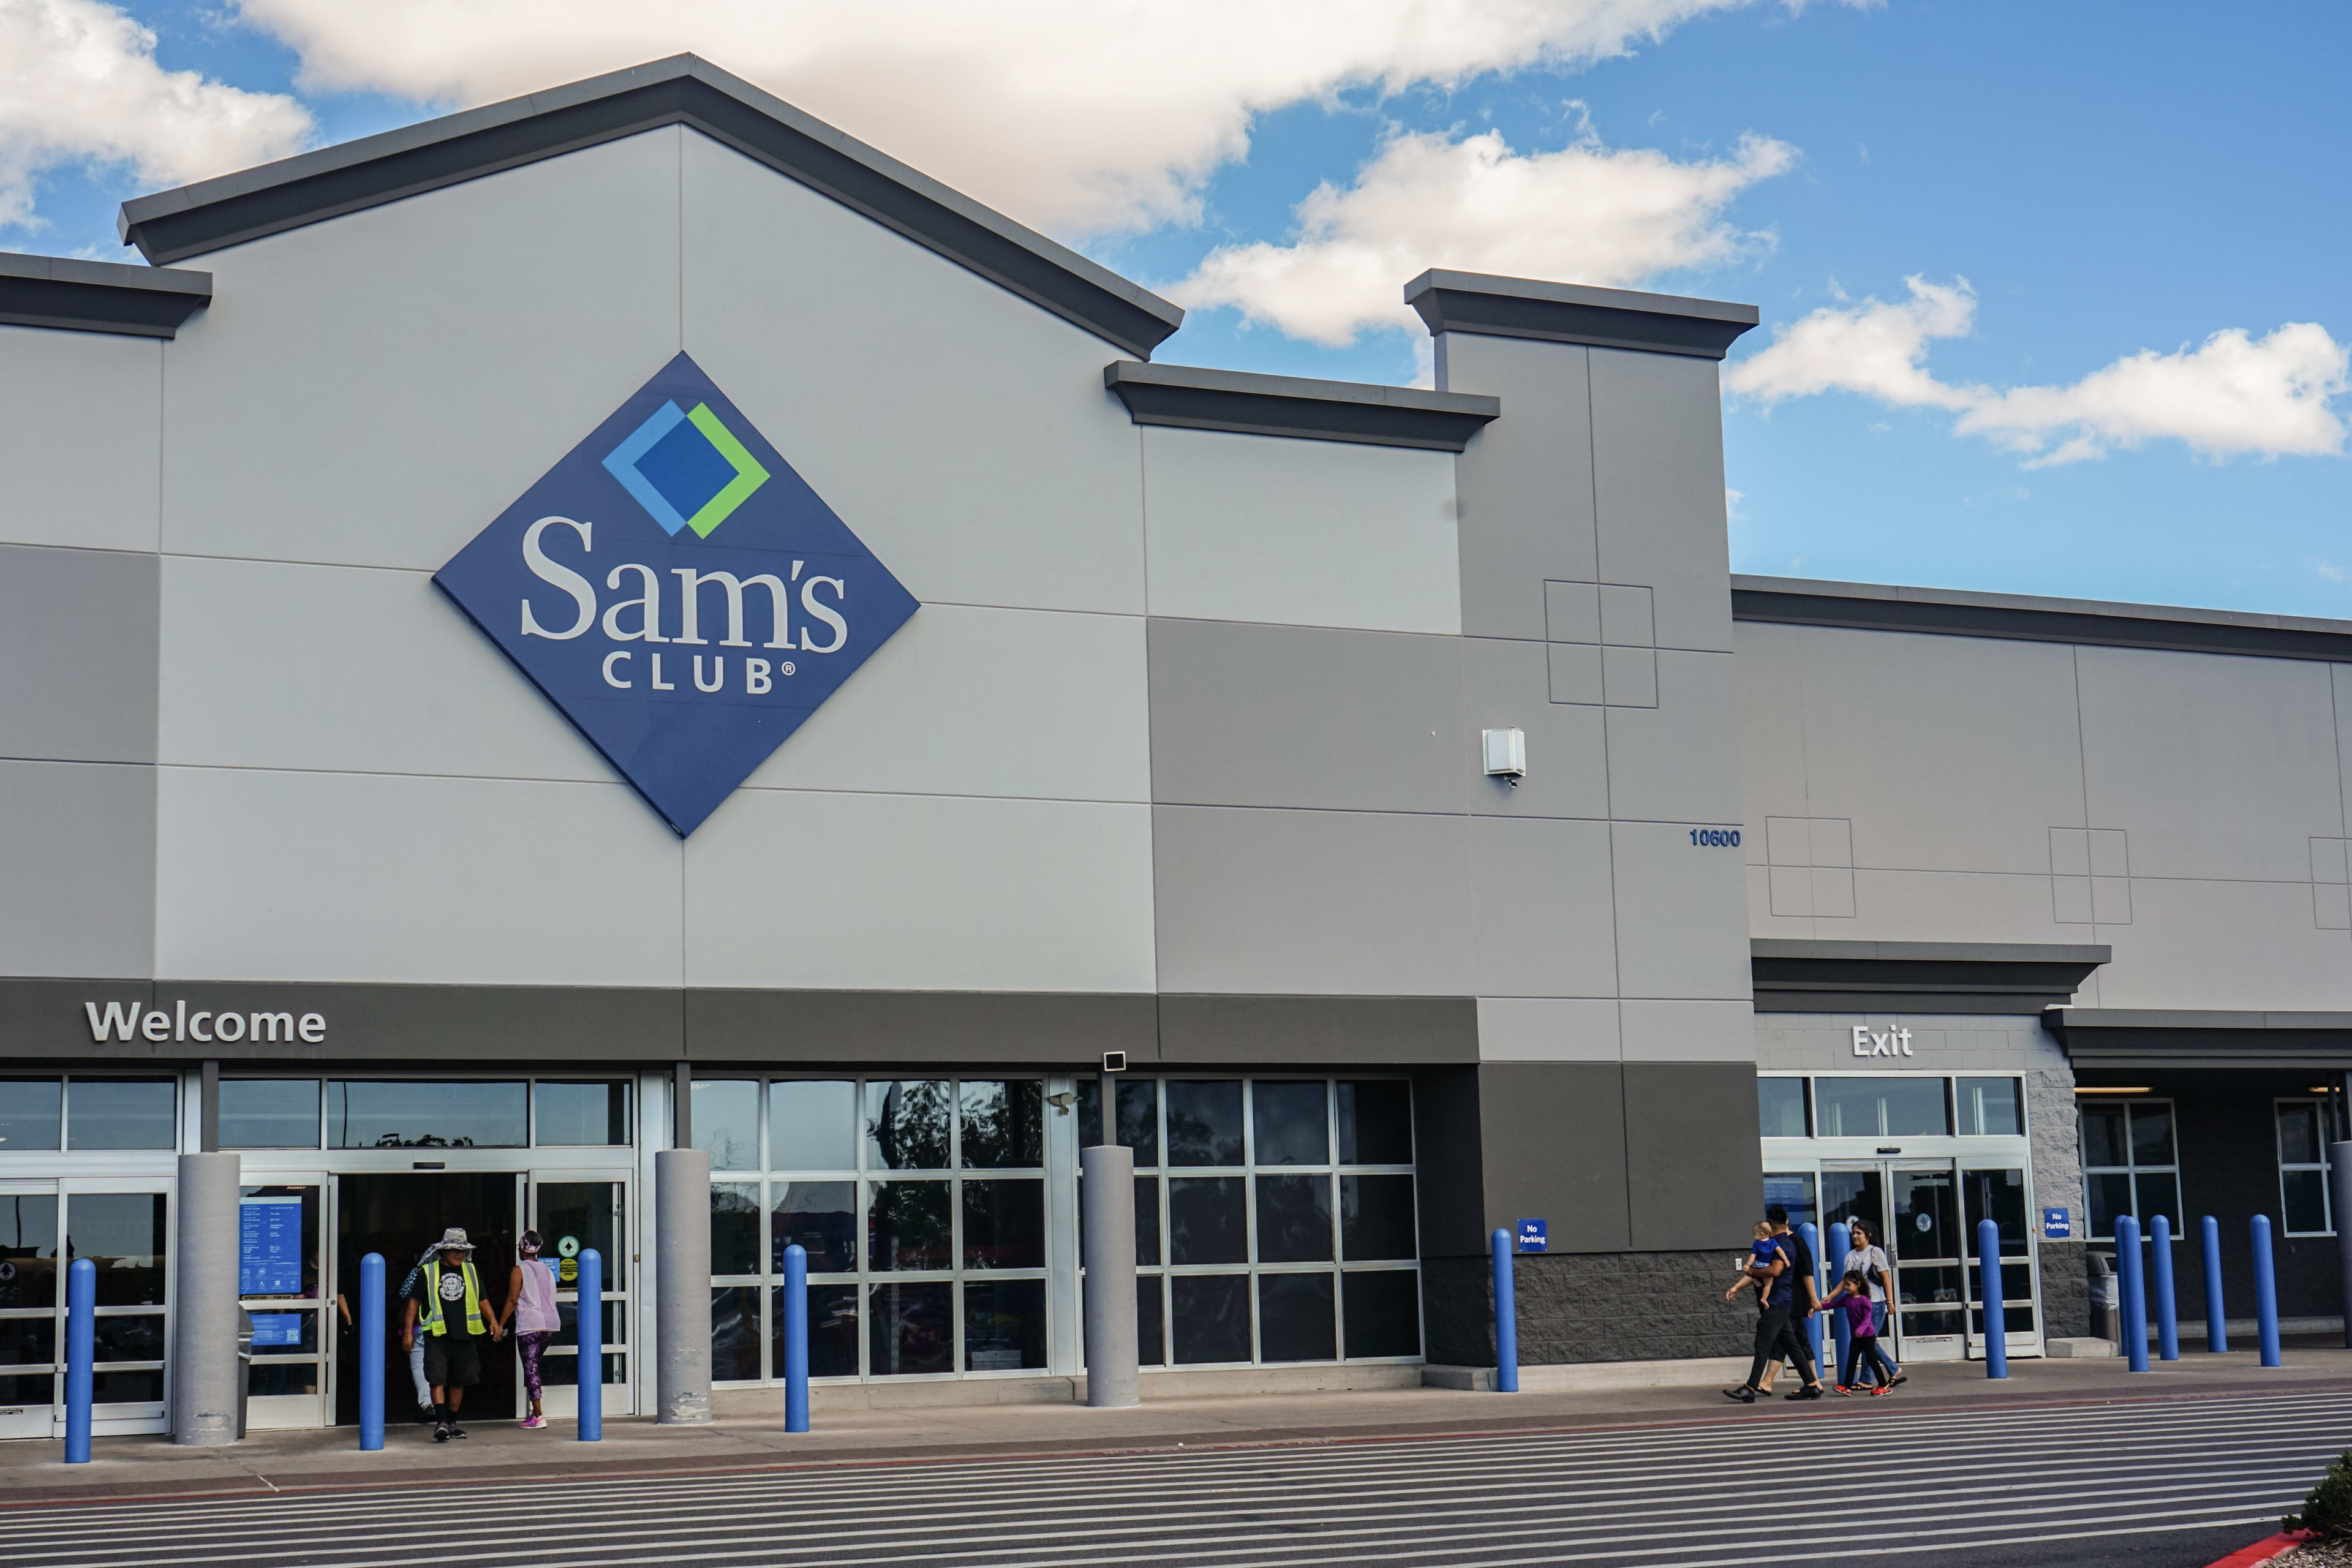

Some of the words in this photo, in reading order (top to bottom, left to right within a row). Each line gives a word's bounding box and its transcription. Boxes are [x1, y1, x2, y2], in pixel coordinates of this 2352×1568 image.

[521, 516, 848, 654] Sam's
[1690, 829, 1741, 847] 10600
[85, 1000, 326, 1042] Welcome
[1852, 1024, 1913, 1057] Exit
[1520, 1235, 1546, 1244] Parking
[1527, 1224, 1537, 1233] No
